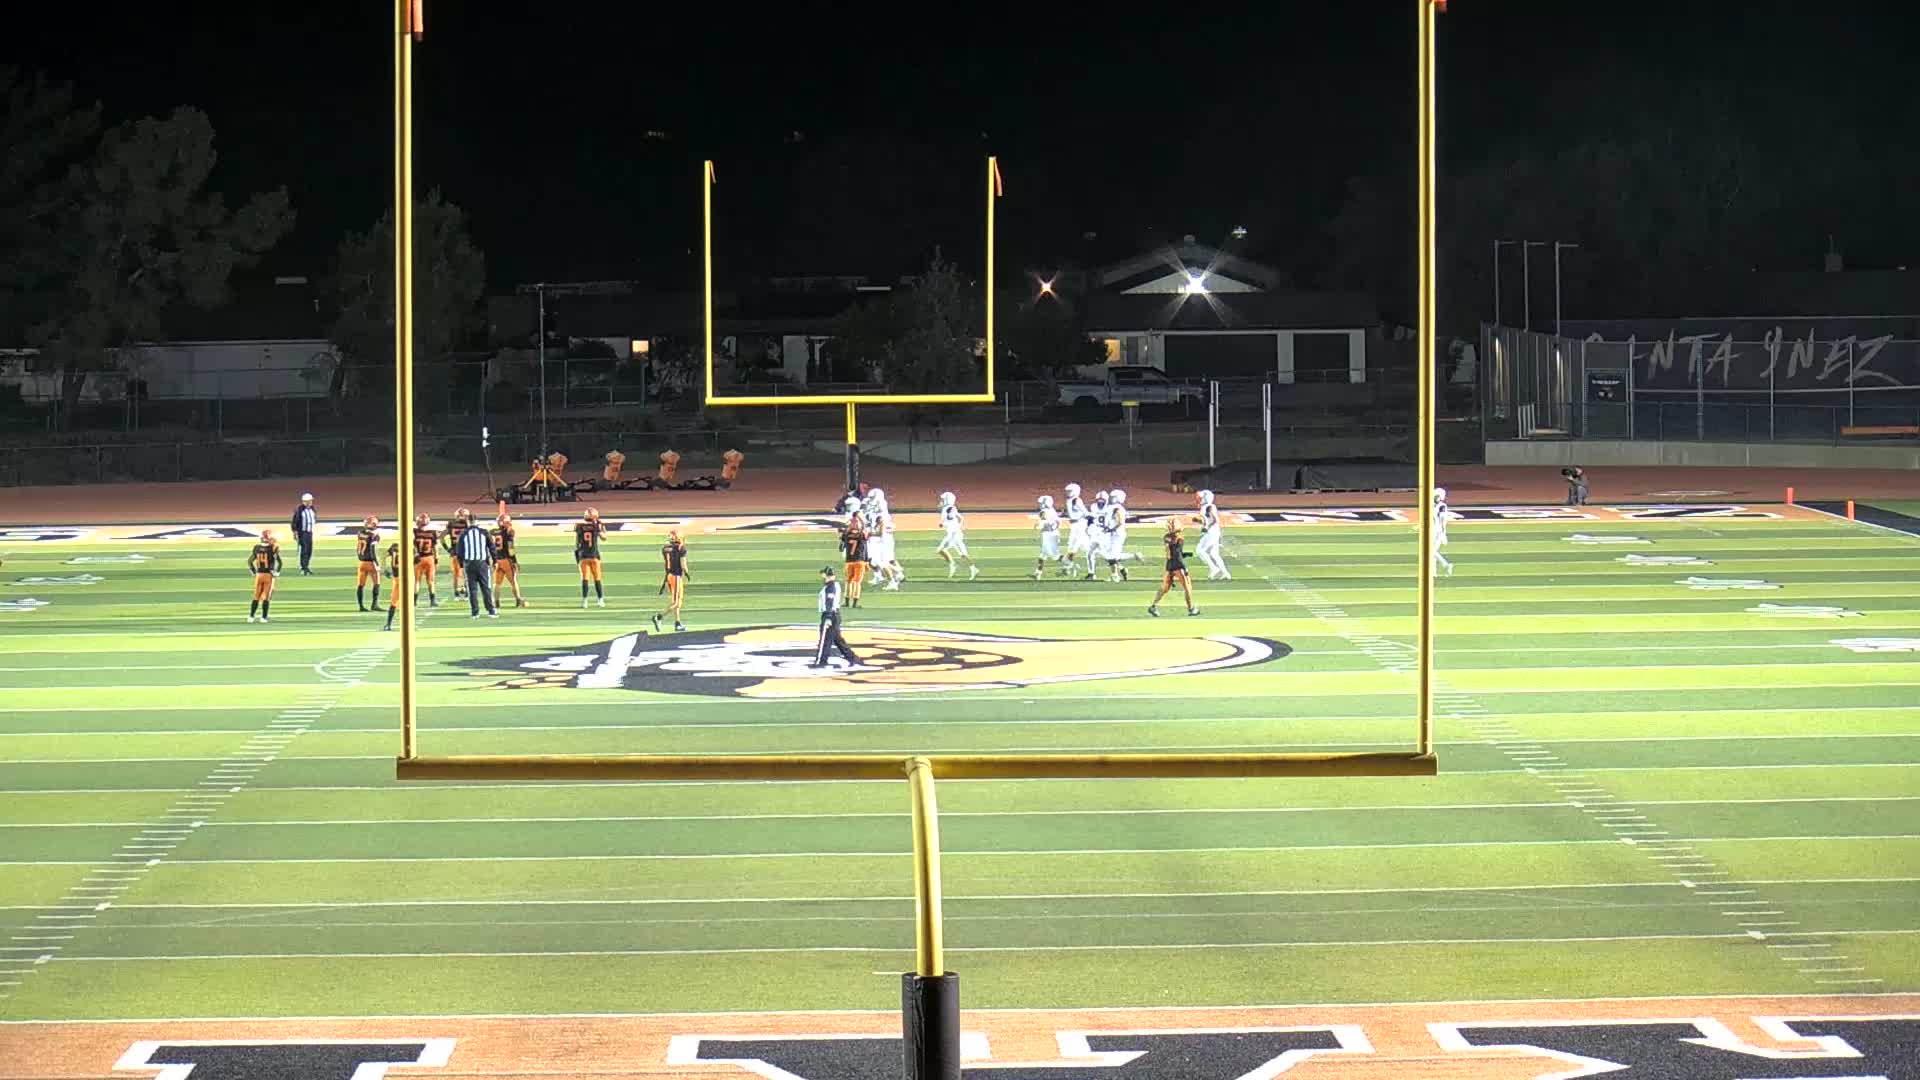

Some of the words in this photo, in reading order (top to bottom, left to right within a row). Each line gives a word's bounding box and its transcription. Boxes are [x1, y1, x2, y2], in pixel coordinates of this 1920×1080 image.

[1583, 328, 1744, 388] NTA
[1759, 326, 1904, 386] YNEZ
[0, 517, 862, 543] SATA
